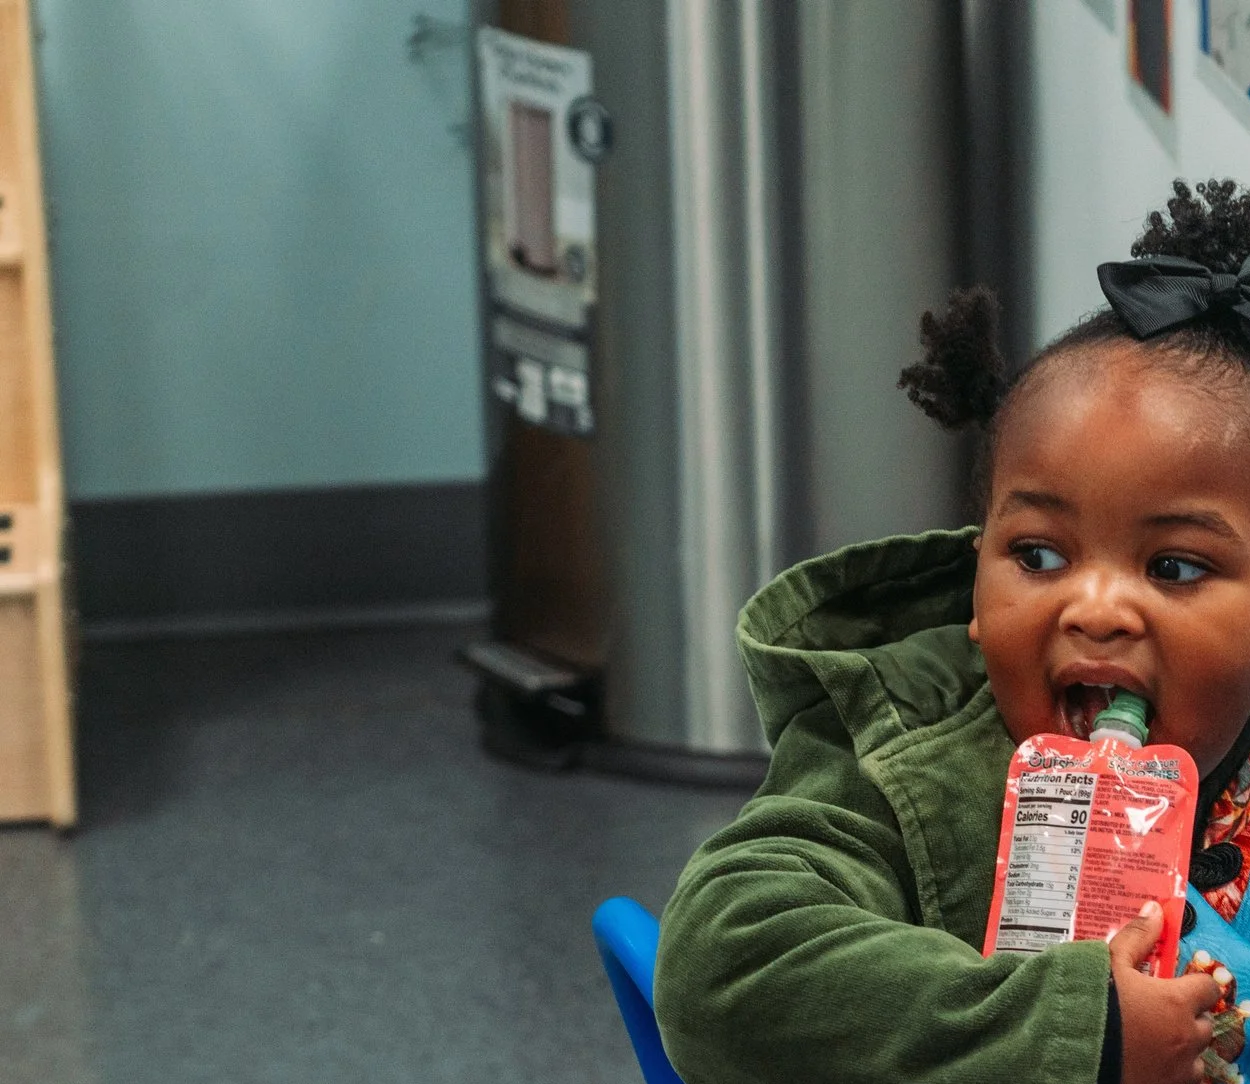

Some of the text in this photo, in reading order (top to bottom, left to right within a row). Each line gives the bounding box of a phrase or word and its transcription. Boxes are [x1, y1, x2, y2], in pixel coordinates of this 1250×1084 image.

[1108, 760, 1180, 779] SMOOTHIES
[1146, 759, 1179, 770] YOGURT
[1021, 772, 1062, 783] Nutrition
[1064, 773, 1094, 785] Facts
[1019, 787, 1035, 795] Serving
[1016, 810, 1049, 822] Calories
[1070, 809, 1088, 825] 90
